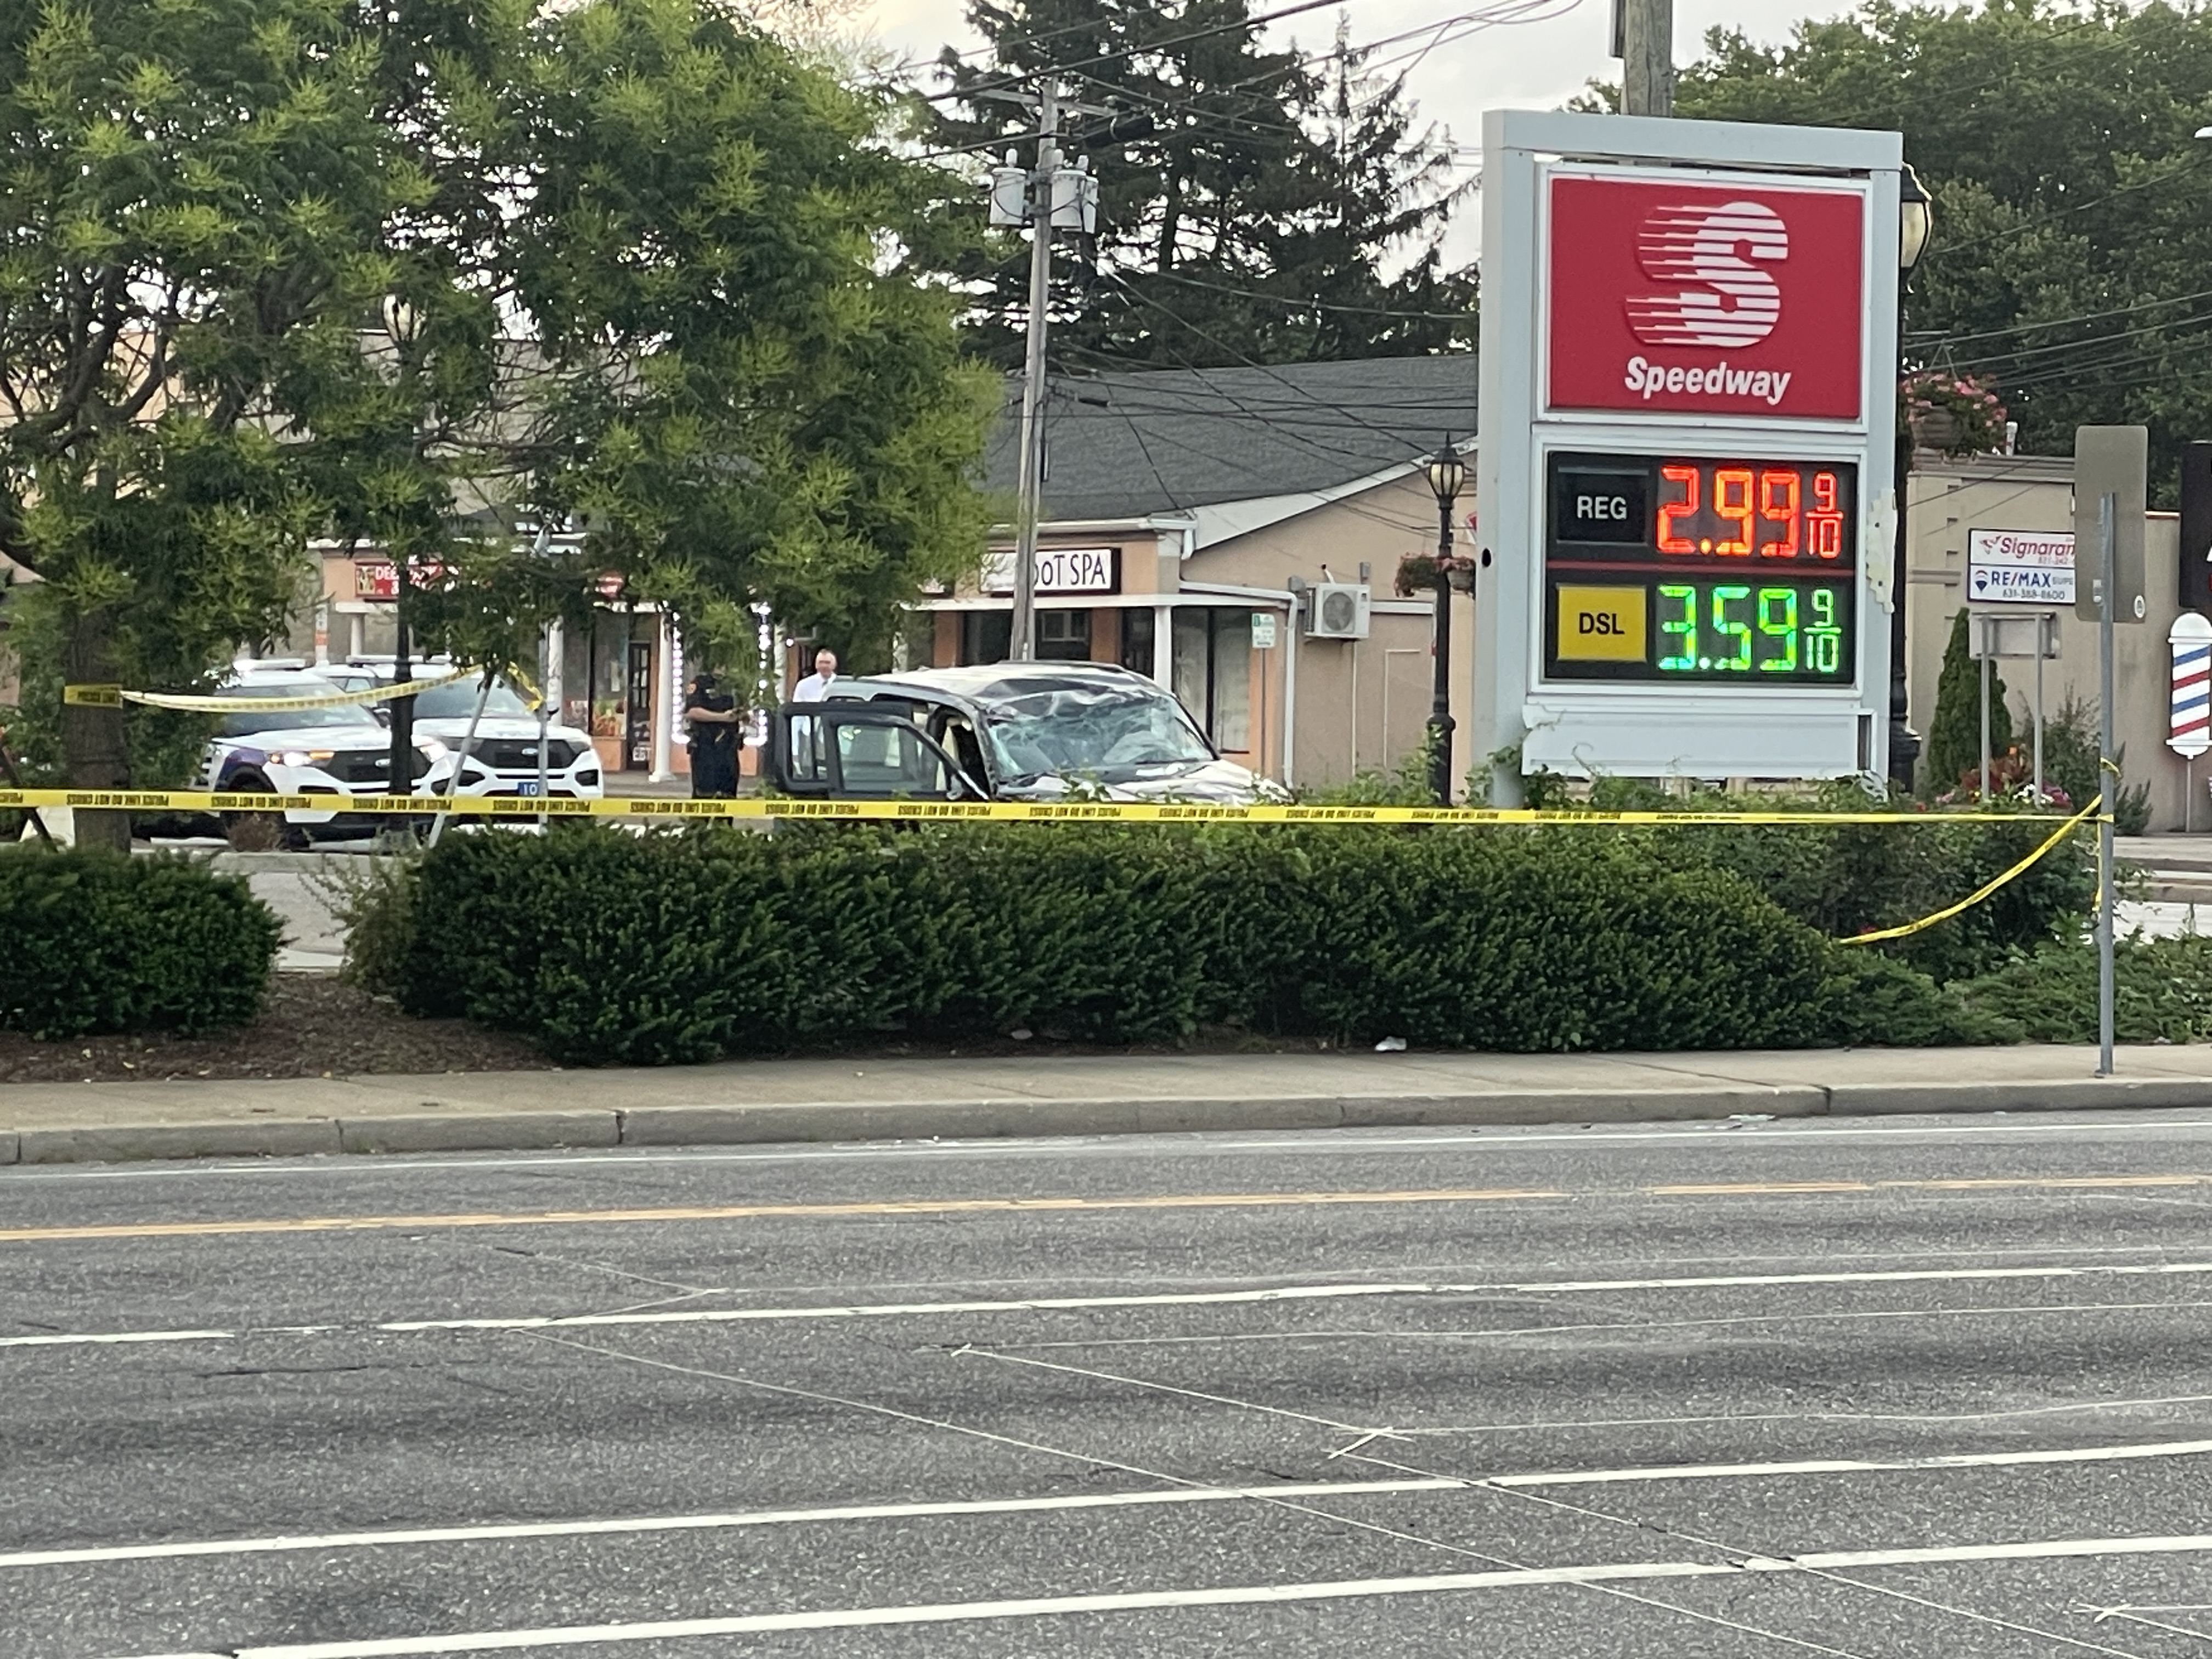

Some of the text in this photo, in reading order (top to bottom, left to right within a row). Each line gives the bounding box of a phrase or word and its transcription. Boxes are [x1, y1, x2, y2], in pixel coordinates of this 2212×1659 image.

[1624, 357, 1791, 404] Speedway
[1577, 496, 1627, 520] REG
[1656, 466, 1801, 557] 2.99
[1070, 554, 1106, 585] SPA
[1991, 571, 2051, 587] RE/MAX
[1578, 613, 1624, 634] DSL
[1658, 585, 1797, 671] 3.59
